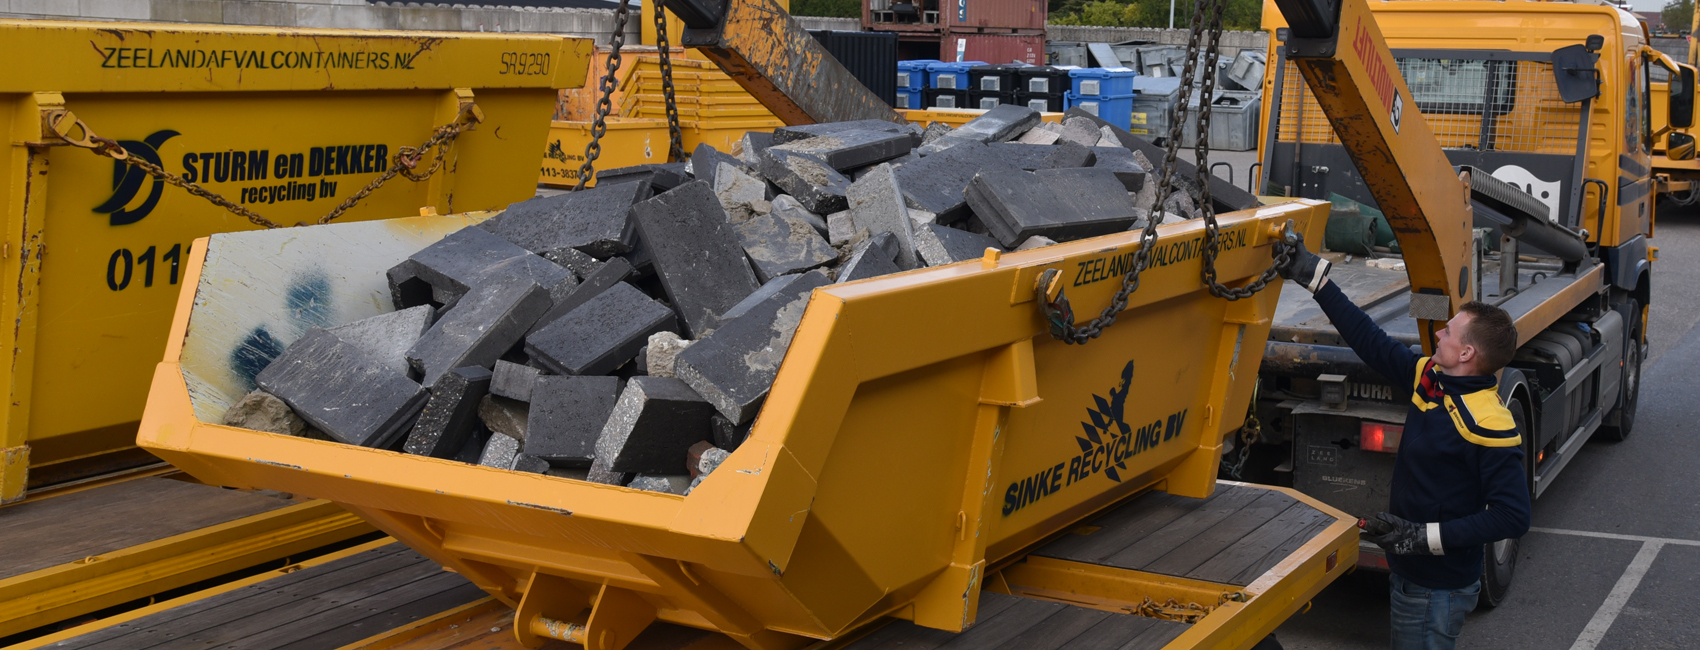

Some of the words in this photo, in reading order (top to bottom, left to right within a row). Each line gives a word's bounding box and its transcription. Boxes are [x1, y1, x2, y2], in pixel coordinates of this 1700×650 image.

[101, 47, 415, 70] ZEELANDAFVALCONTAINERS.NL
[182, 150, 239, 184] STURM
[274, 152, 304, 179] en
[309, 144, 389, 177] DEKKER
[240, 181, 316, 205] recycling
[319, 179, 338, 199] bv
[106, 243, 193, 292] 011
[1002, 461, 1066, 517] SINKE
[1056, 419, 1163, 487] RECYCLING
[1163, 408, 1188, 442] BV
